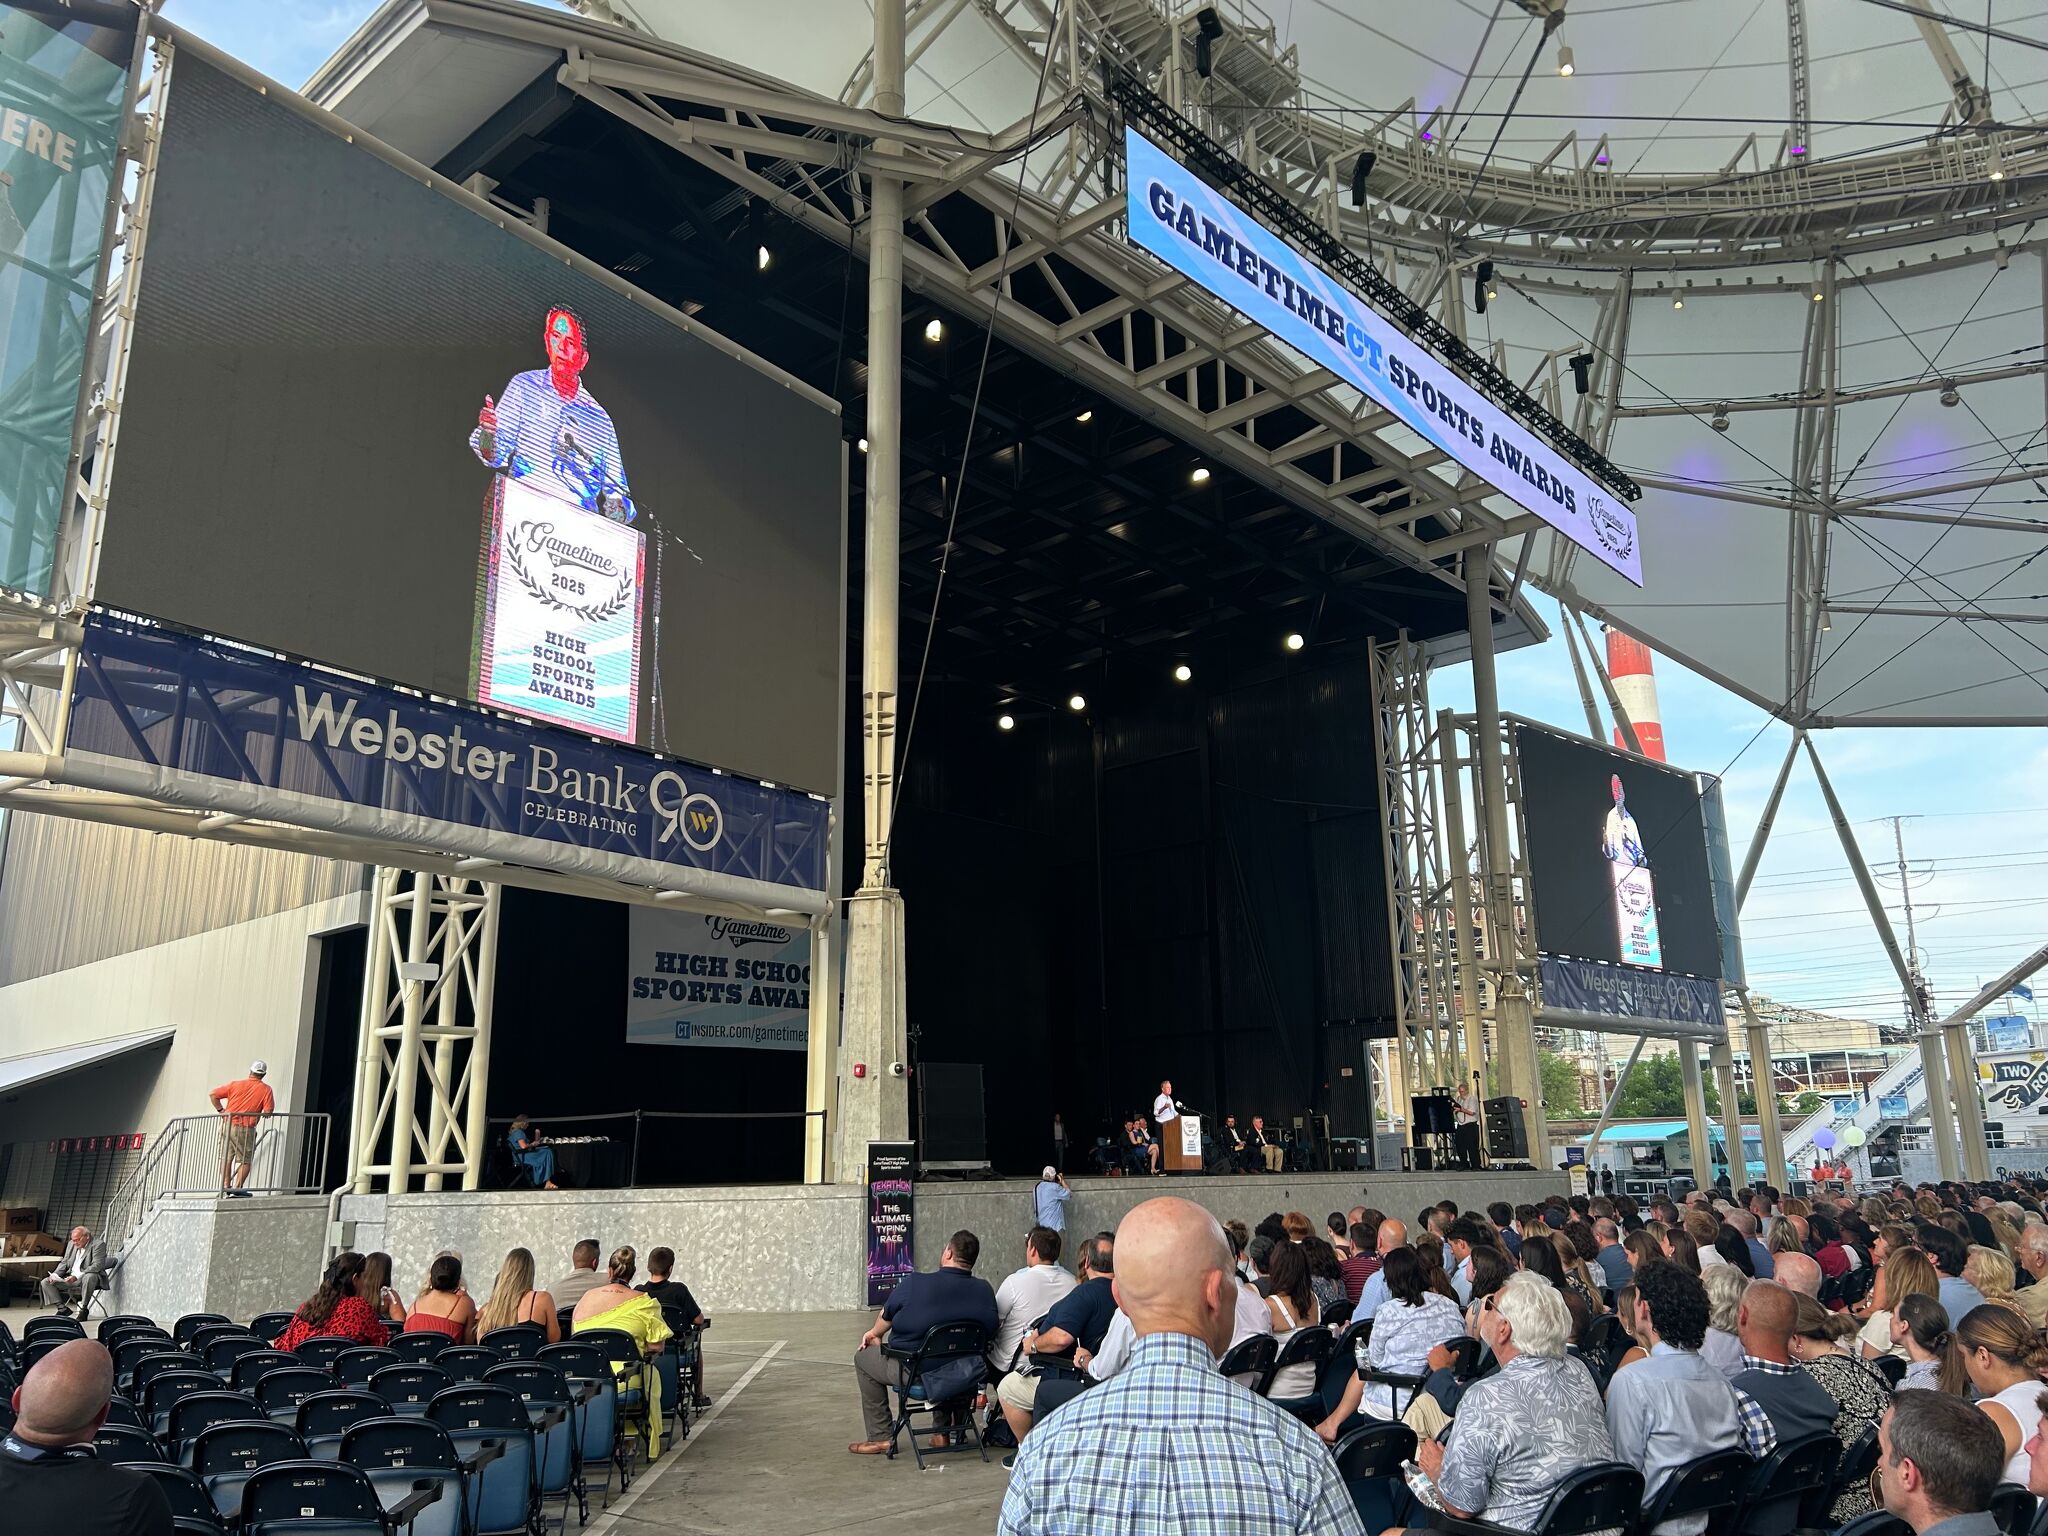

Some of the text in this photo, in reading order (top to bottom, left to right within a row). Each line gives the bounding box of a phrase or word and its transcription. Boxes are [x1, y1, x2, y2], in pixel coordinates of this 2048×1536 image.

[1149, 182, 1577, 515] GAMETIMECT SPORTS AWARDS
[521, 520, 616, 573] Gametime
[552, 573, 585, 595] 2025
[545, 630, 587, 654] HIGH
[533, 645, 596, 674] SCHOOL
[532, 663, 595, 691] SPORTS
[528, 679, 596, 708] AWARDS
[294, 684, 516, 784] Webster
[524, 802, 637, 836] CELEBRATING
[705, 915, 790, 941] Gametime
[655, 952, 811, 985] HIGH SCHOO
[633, 976, 743, 1004] SPORTS
[1581, 967, 1632, 994] Webster
[1635, 975, 1665, 999] Bank
[691, 1023, 808, 1043] INSIDER.com/gametimec
[2001, 1065, 2031, 1078] TWO
[2031, 1066, 2048, 1093] RO
[871, 1214, 911, 1223] ULTIMATE
[883, 1204, 901, 1213] THE
[876, 1224, 907, 1234] TYPING
[880, 1234, 903, 1243] RACE
